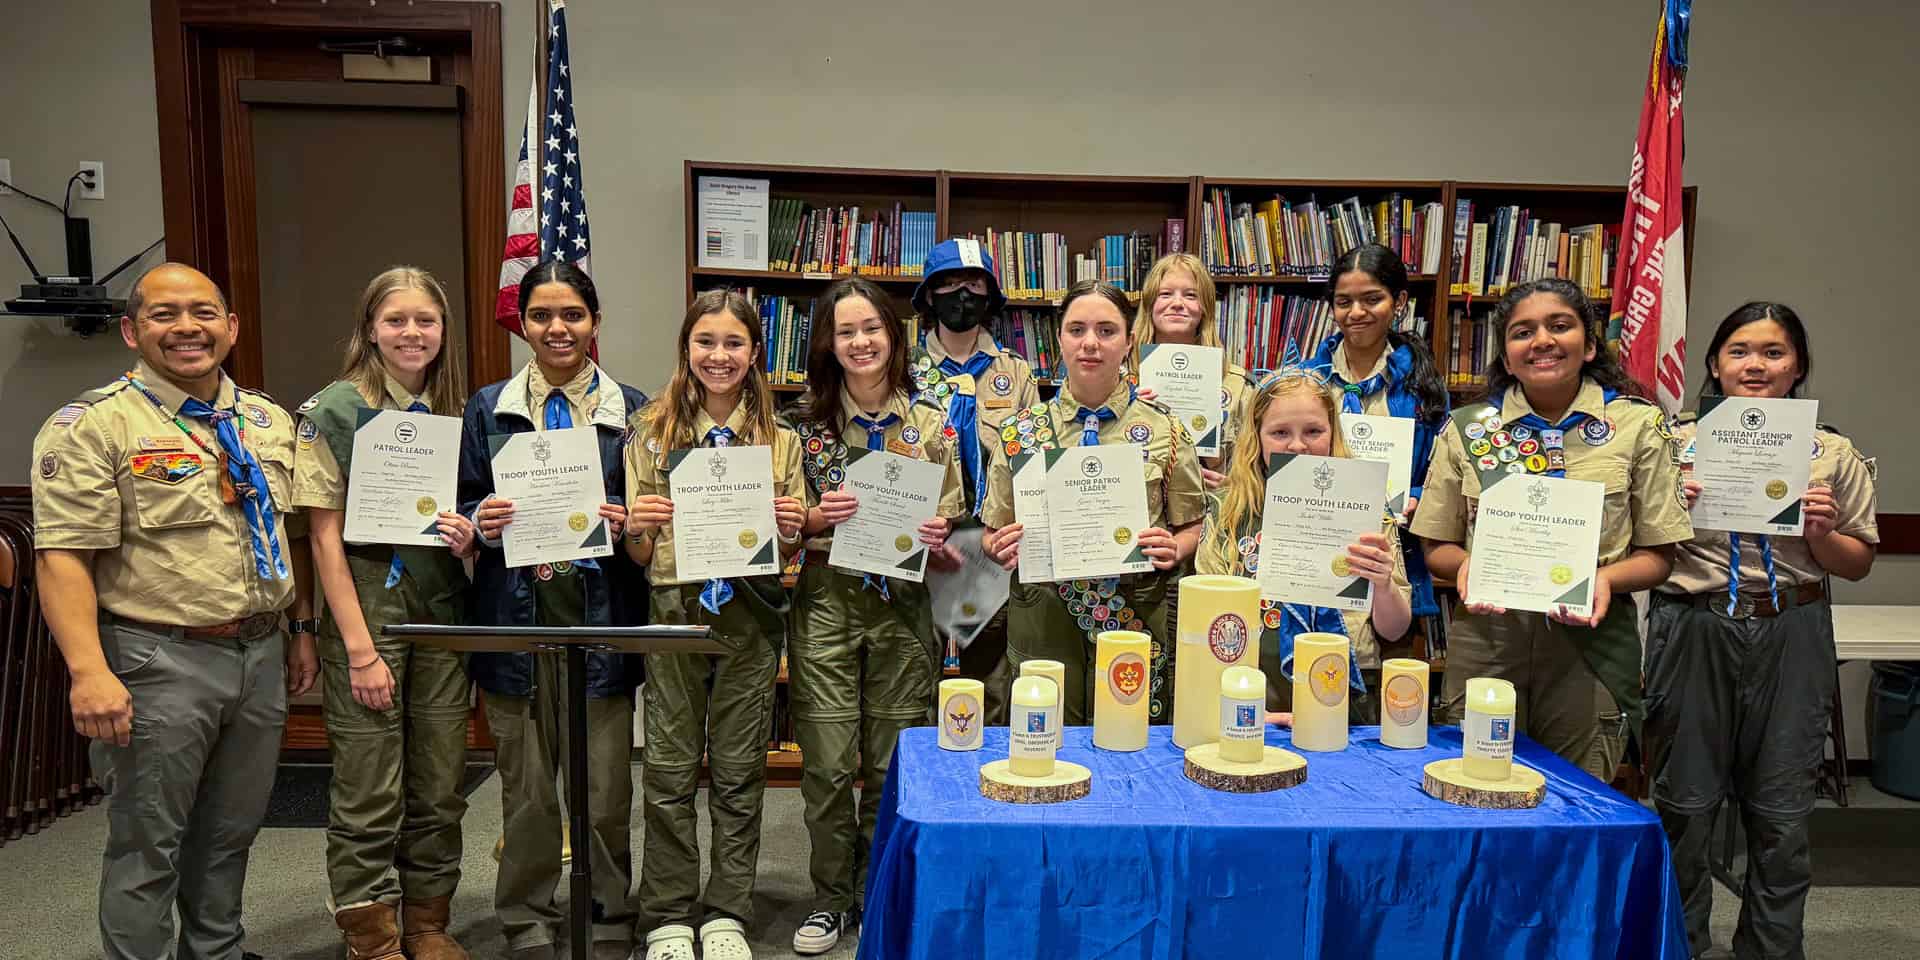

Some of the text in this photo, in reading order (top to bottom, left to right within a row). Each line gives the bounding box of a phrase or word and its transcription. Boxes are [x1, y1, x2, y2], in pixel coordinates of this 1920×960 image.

[1156, 371, 1203, 380] PATROL LEADER
[1711, 429, 1793, 441] ASSISTANT SENIOR
[1717, 437, 1785, 448] PATROL LEADER
[373, 443, 434, 456] PATROL LEADER
[499, 464, 589, 480] TROOP YOUTH LEADER
[1064, 476, 1121, 487] SENIOR PATROL
[677, 482, 762, 494] TROOP YOUTH LEADER
[850, 479, 875, 490] TROOP
[876, 485, 901, 497] YOUTH
[901, 491, 928, 503] LEADER
[1079, 484, 1107, 493] LEADER
[1272, 494, 1370, 512] TROOP YOUTH LEADER
[1485, 507, 1586, 527] TROOP YOUTH LEADER
